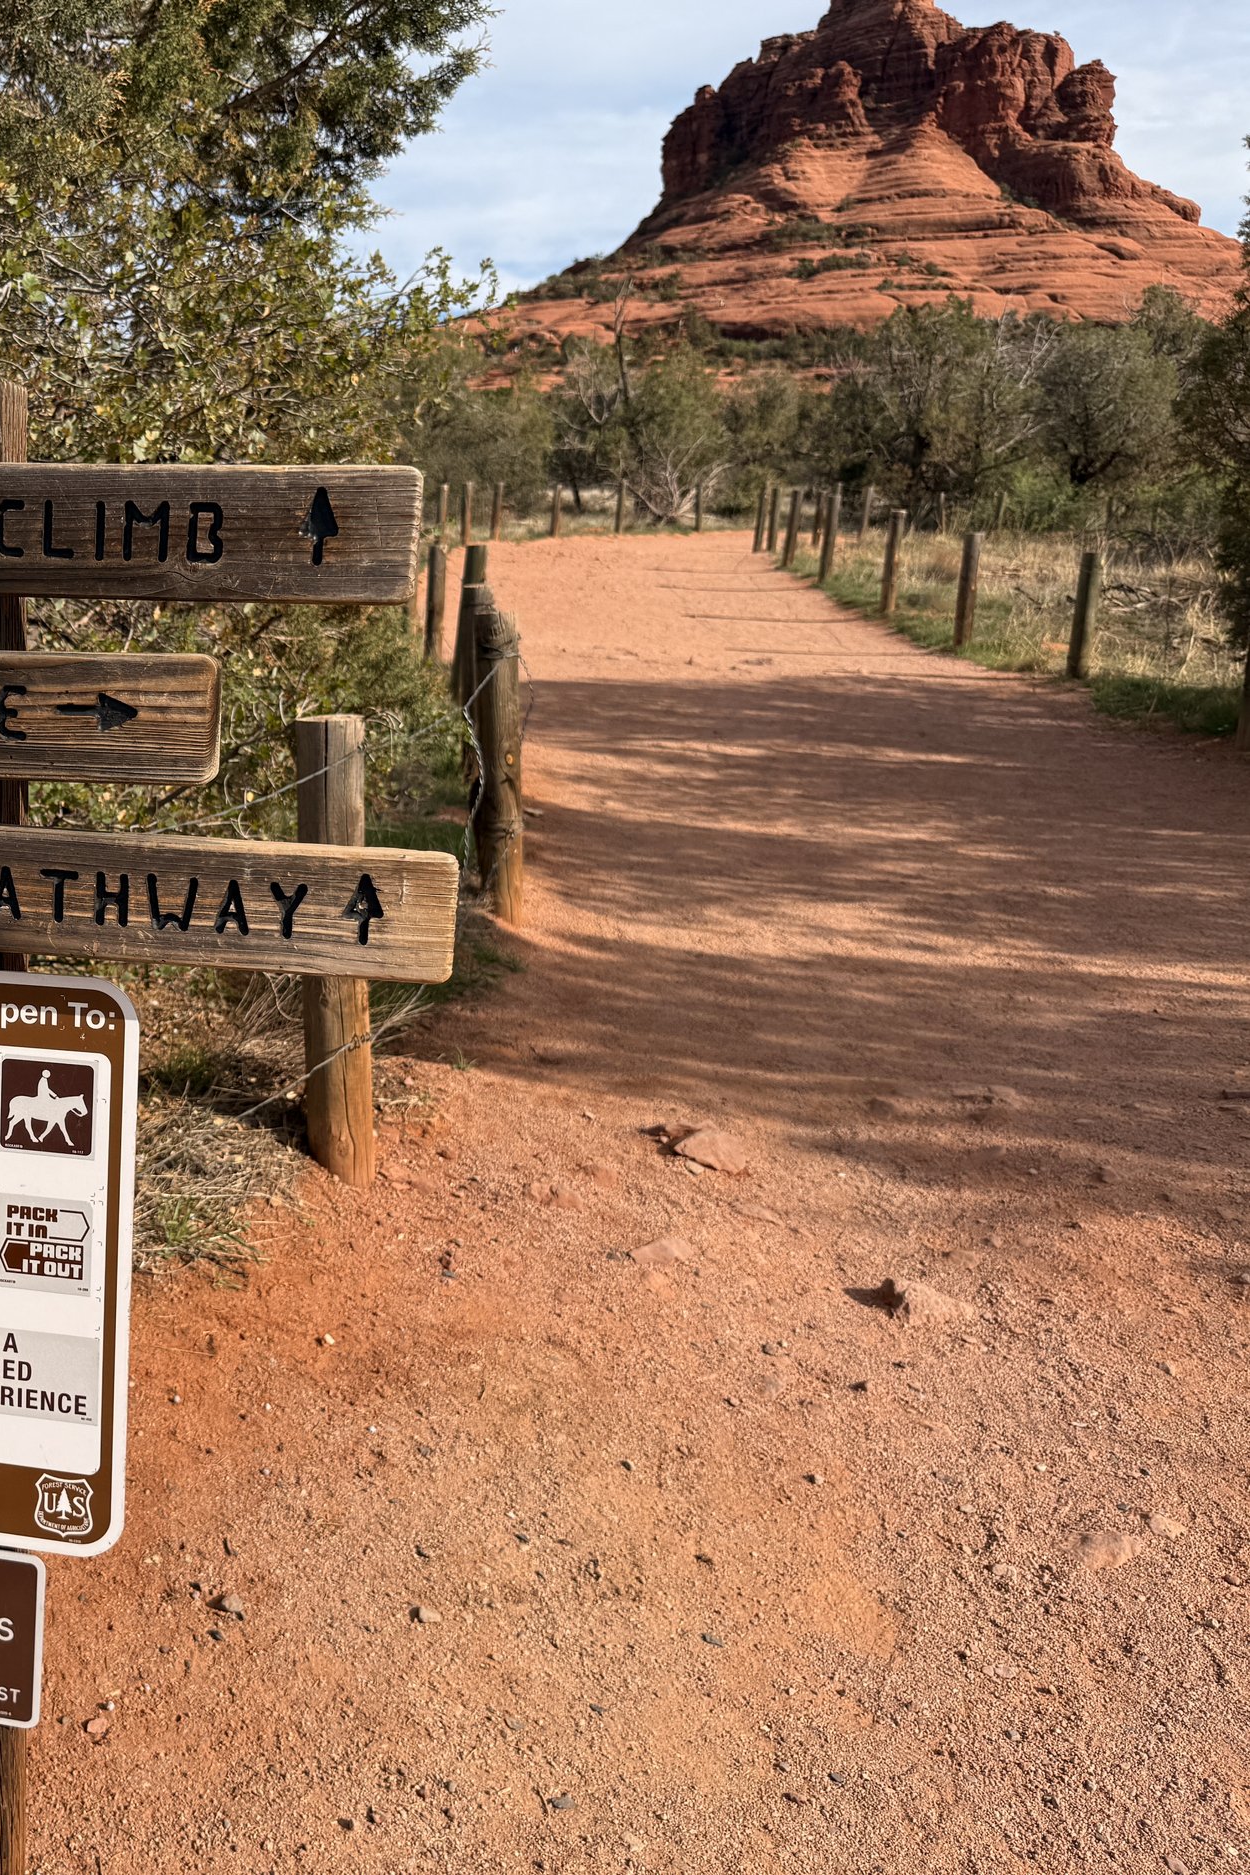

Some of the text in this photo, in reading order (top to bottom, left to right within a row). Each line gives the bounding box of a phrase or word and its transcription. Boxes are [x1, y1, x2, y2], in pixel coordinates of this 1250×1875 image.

[68, 1001, 116, 1031] To:
[7, 1204, 58, 1223] PACK
[6, 1221, 25, 1237] IT
[30, 1242, 82, 1262] PACK
[22, 1258, 82, 1279] IT OUT
[3, 1332, 19, 1354] A
[41, 1481, 87, 1497] FOREST SERVICE
